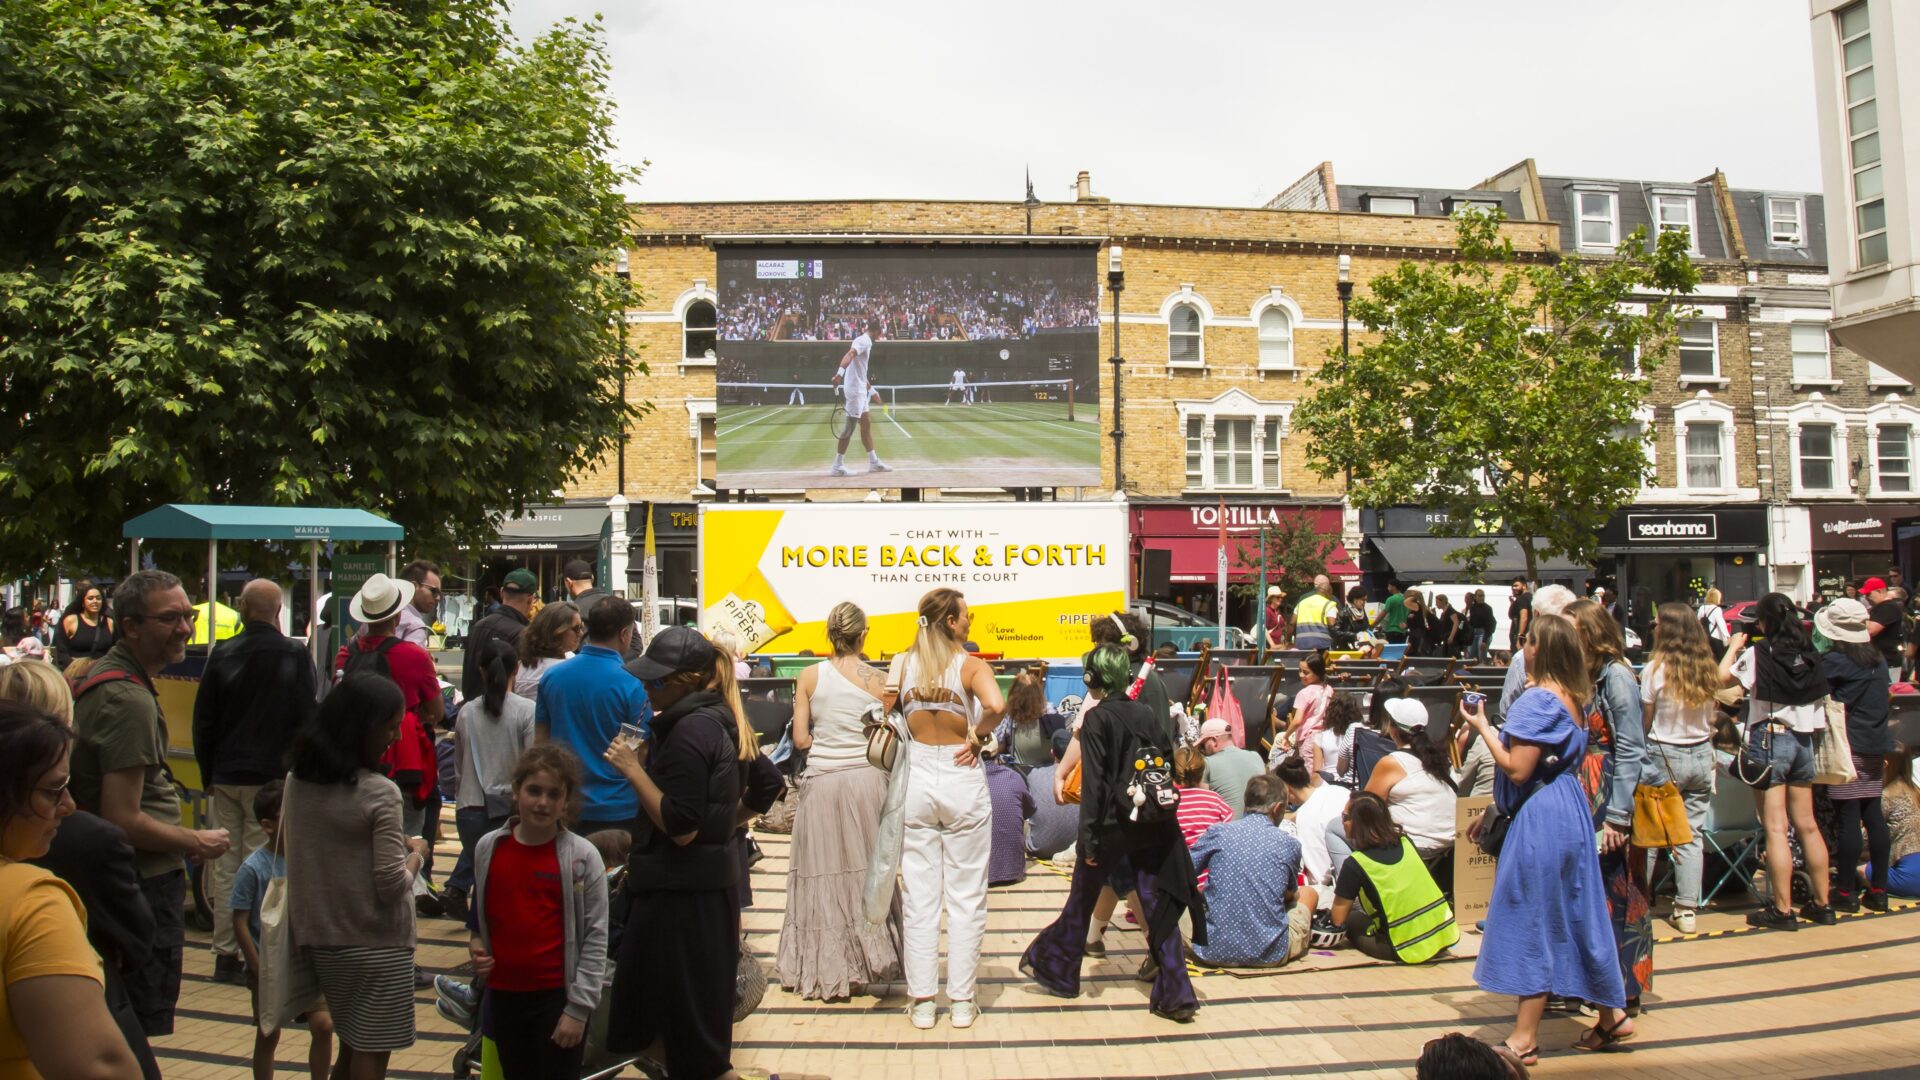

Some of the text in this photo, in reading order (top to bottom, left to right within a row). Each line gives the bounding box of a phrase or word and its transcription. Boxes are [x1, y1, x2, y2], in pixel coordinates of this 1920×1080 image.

[1034, 392, 1048, 400] 122
[1190, 507, 1280, 525] TORTILLA
[294, 526, 330, 534] WAHACA
[906, 530, 984, 539] CHAT WITH
[1638, 519, 1708, 536] seanhanna
[782, 543, 1106, 568] MORE BACK & FORTH
[871, 572, 1019, 583] THAN CENTRE COURT
[725, 600, 760, 644] PIPERS
